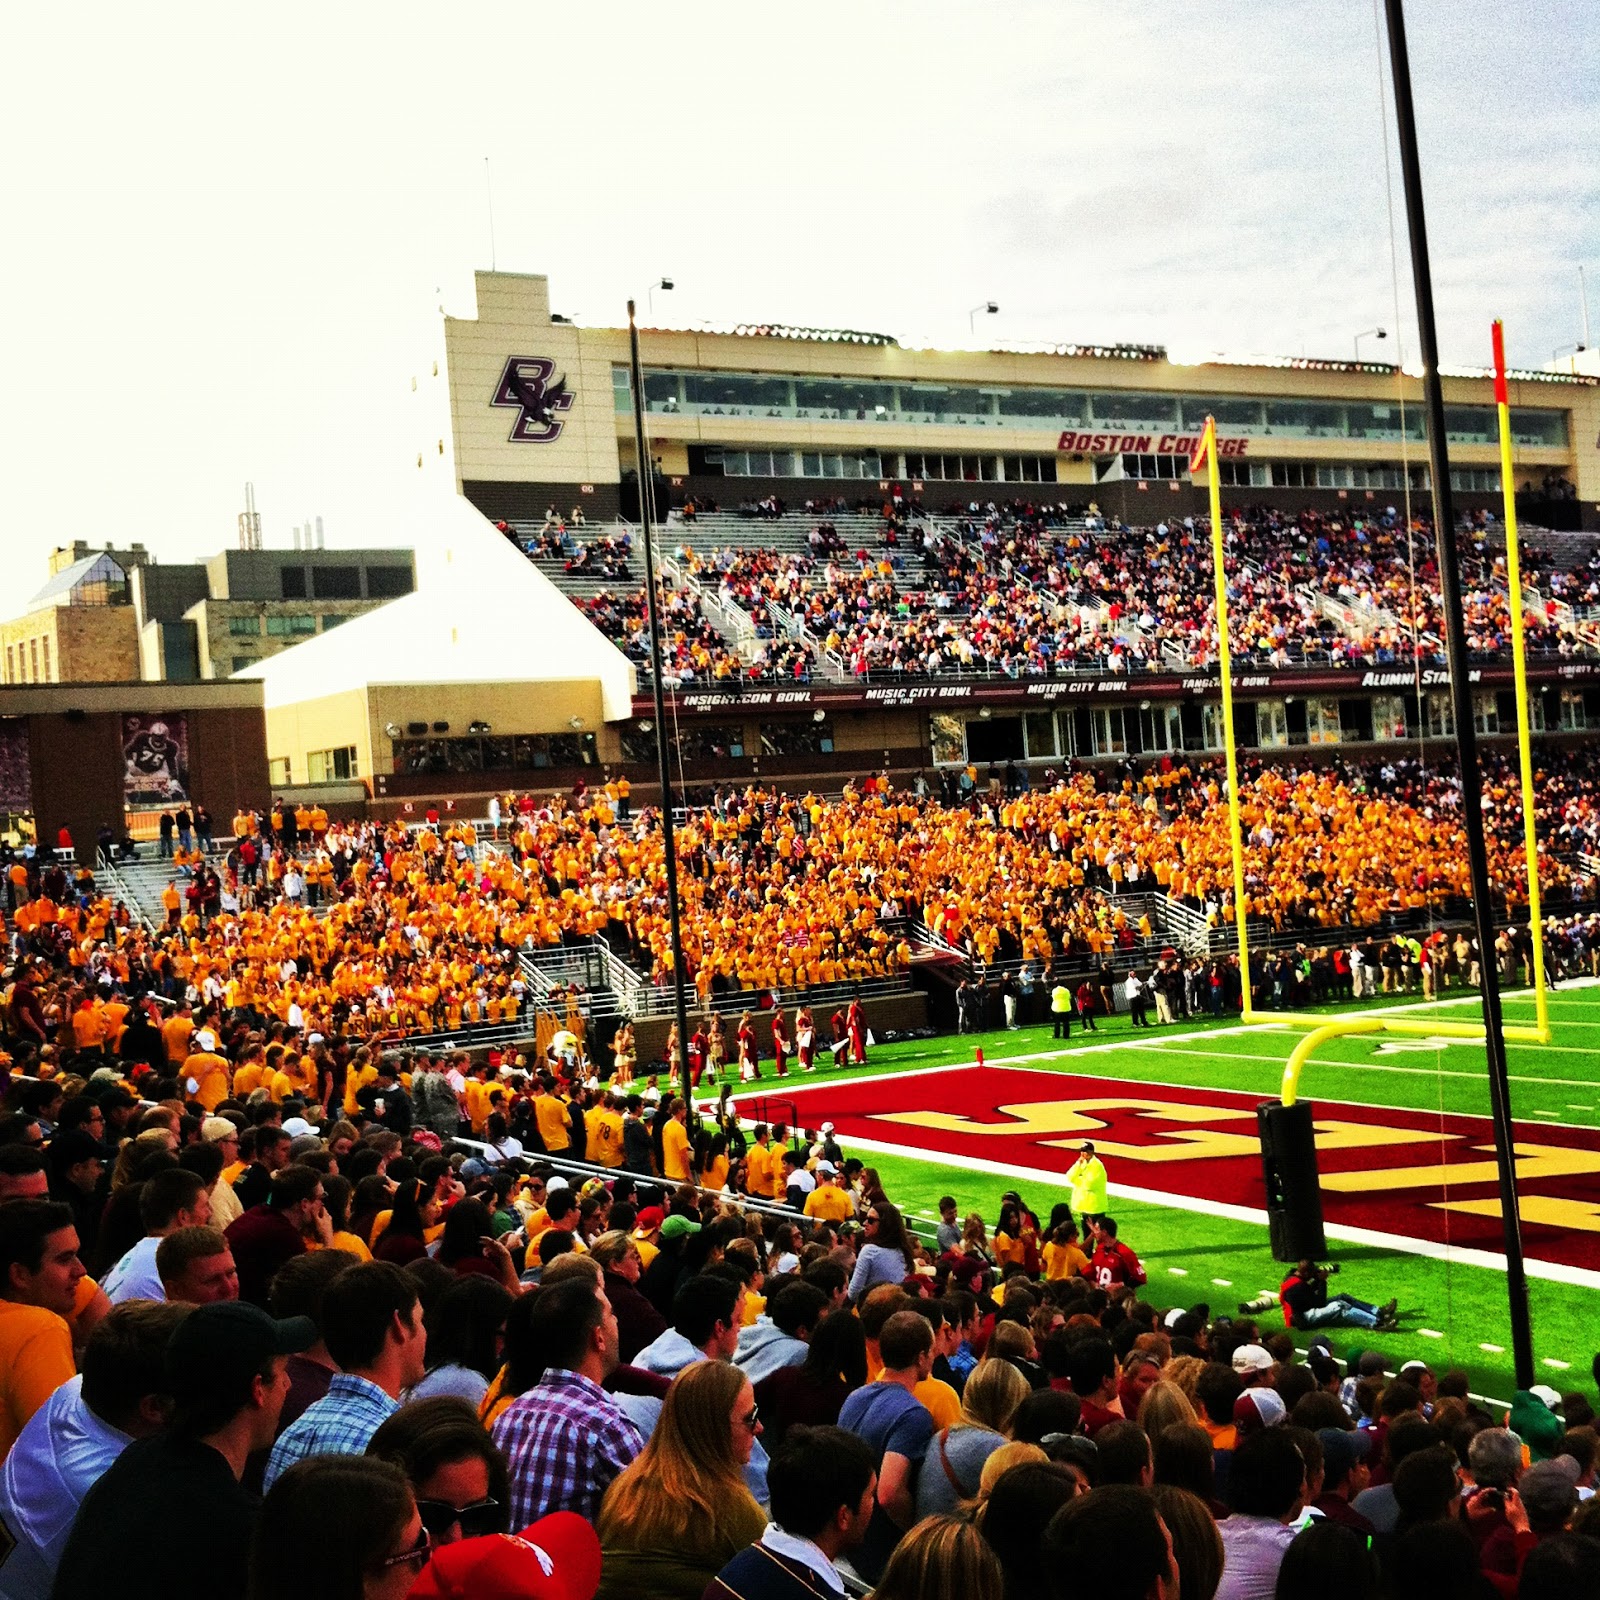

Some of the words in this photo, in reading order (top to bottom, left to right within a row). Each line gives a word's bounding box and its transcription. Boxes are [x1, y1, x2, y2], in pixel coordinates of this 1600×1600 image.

[1057, 431, 1152, 453] BOSTON
[1027, 683, 1067, 695] MOTOR
[1069, 682, 1095, 693] CITY
[1098, 681, 1128, 692] BOWL
[1242, 676, 1271, 687] BOWL
[776, 691, 812, 703] BOWL
[865, 688, 907, 700] MUSIC
[909, 687, 938, 698] CITY
[939, 686, 972, 697] BOWL
